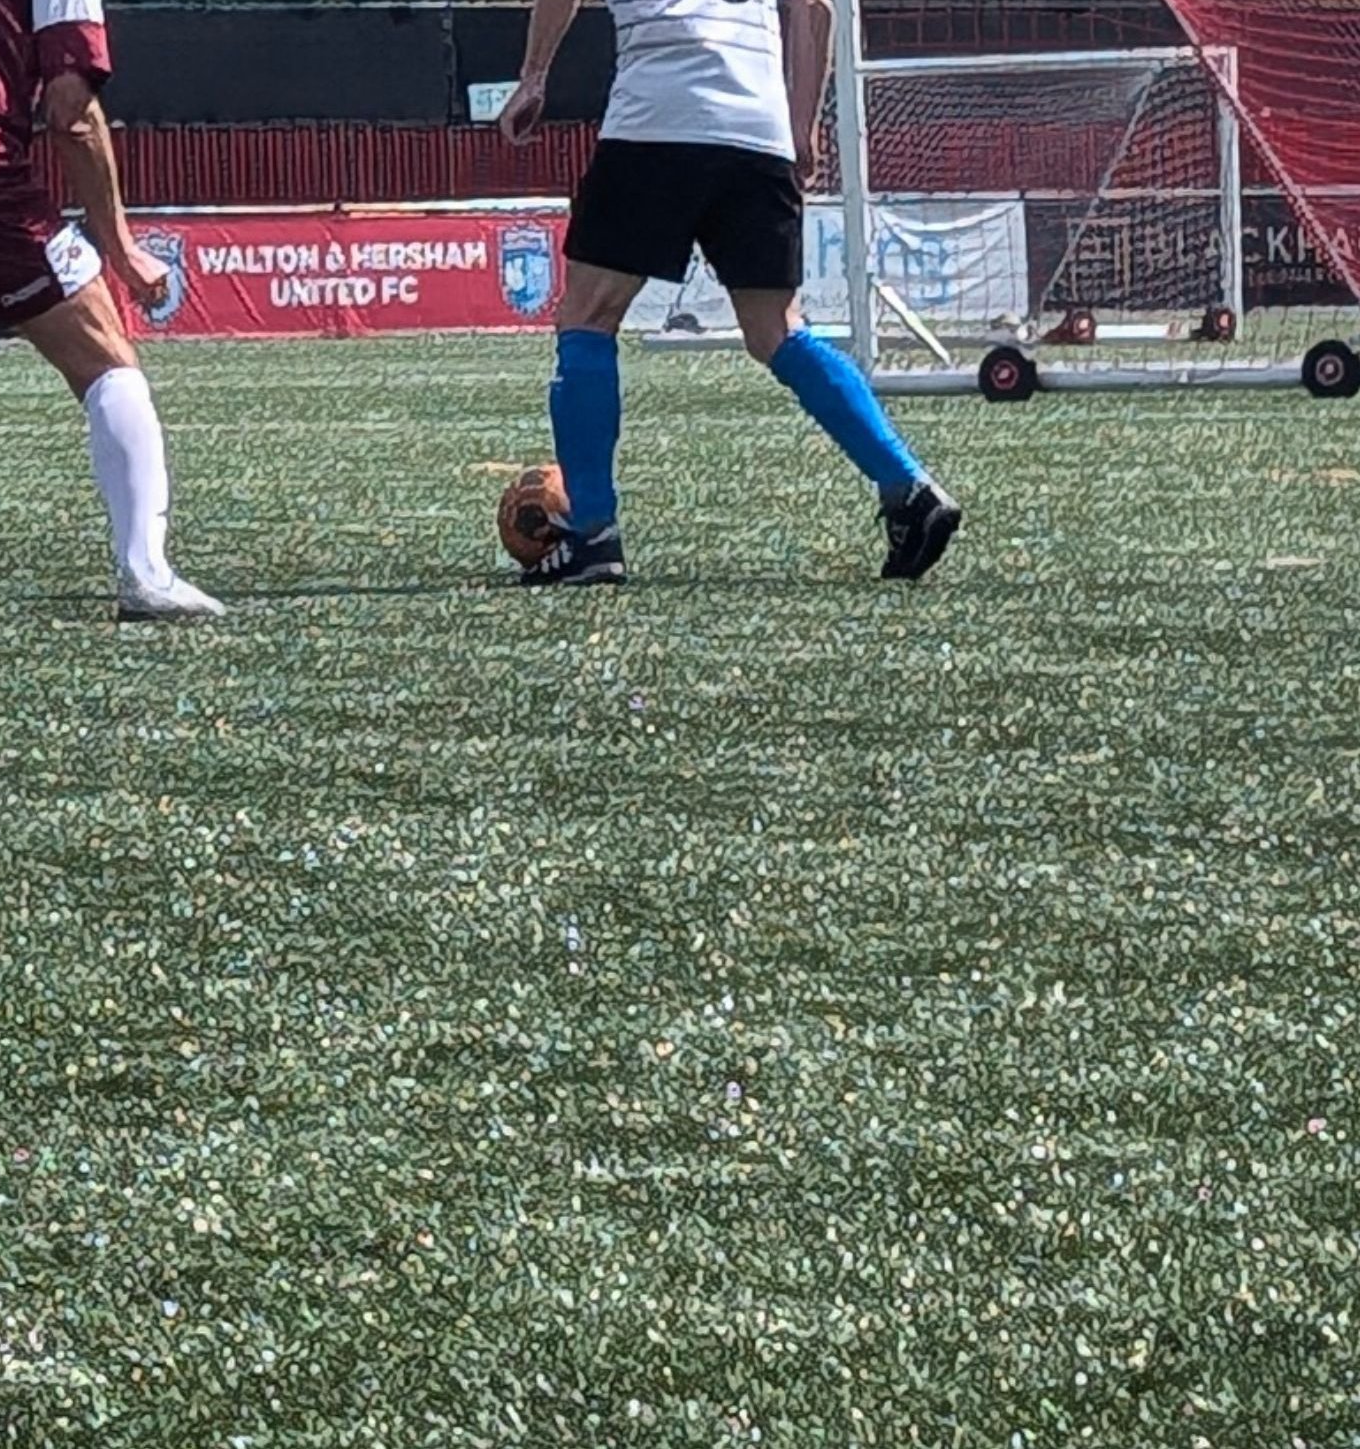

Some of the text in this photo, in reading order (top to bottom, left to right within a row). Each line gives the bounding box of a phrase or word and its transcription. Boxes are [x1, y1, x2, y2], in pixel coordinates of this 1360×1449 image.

[196, 240, 488, 274] WALTON & HERSHAM
[269, 275, 419, 308] UNITED FC
